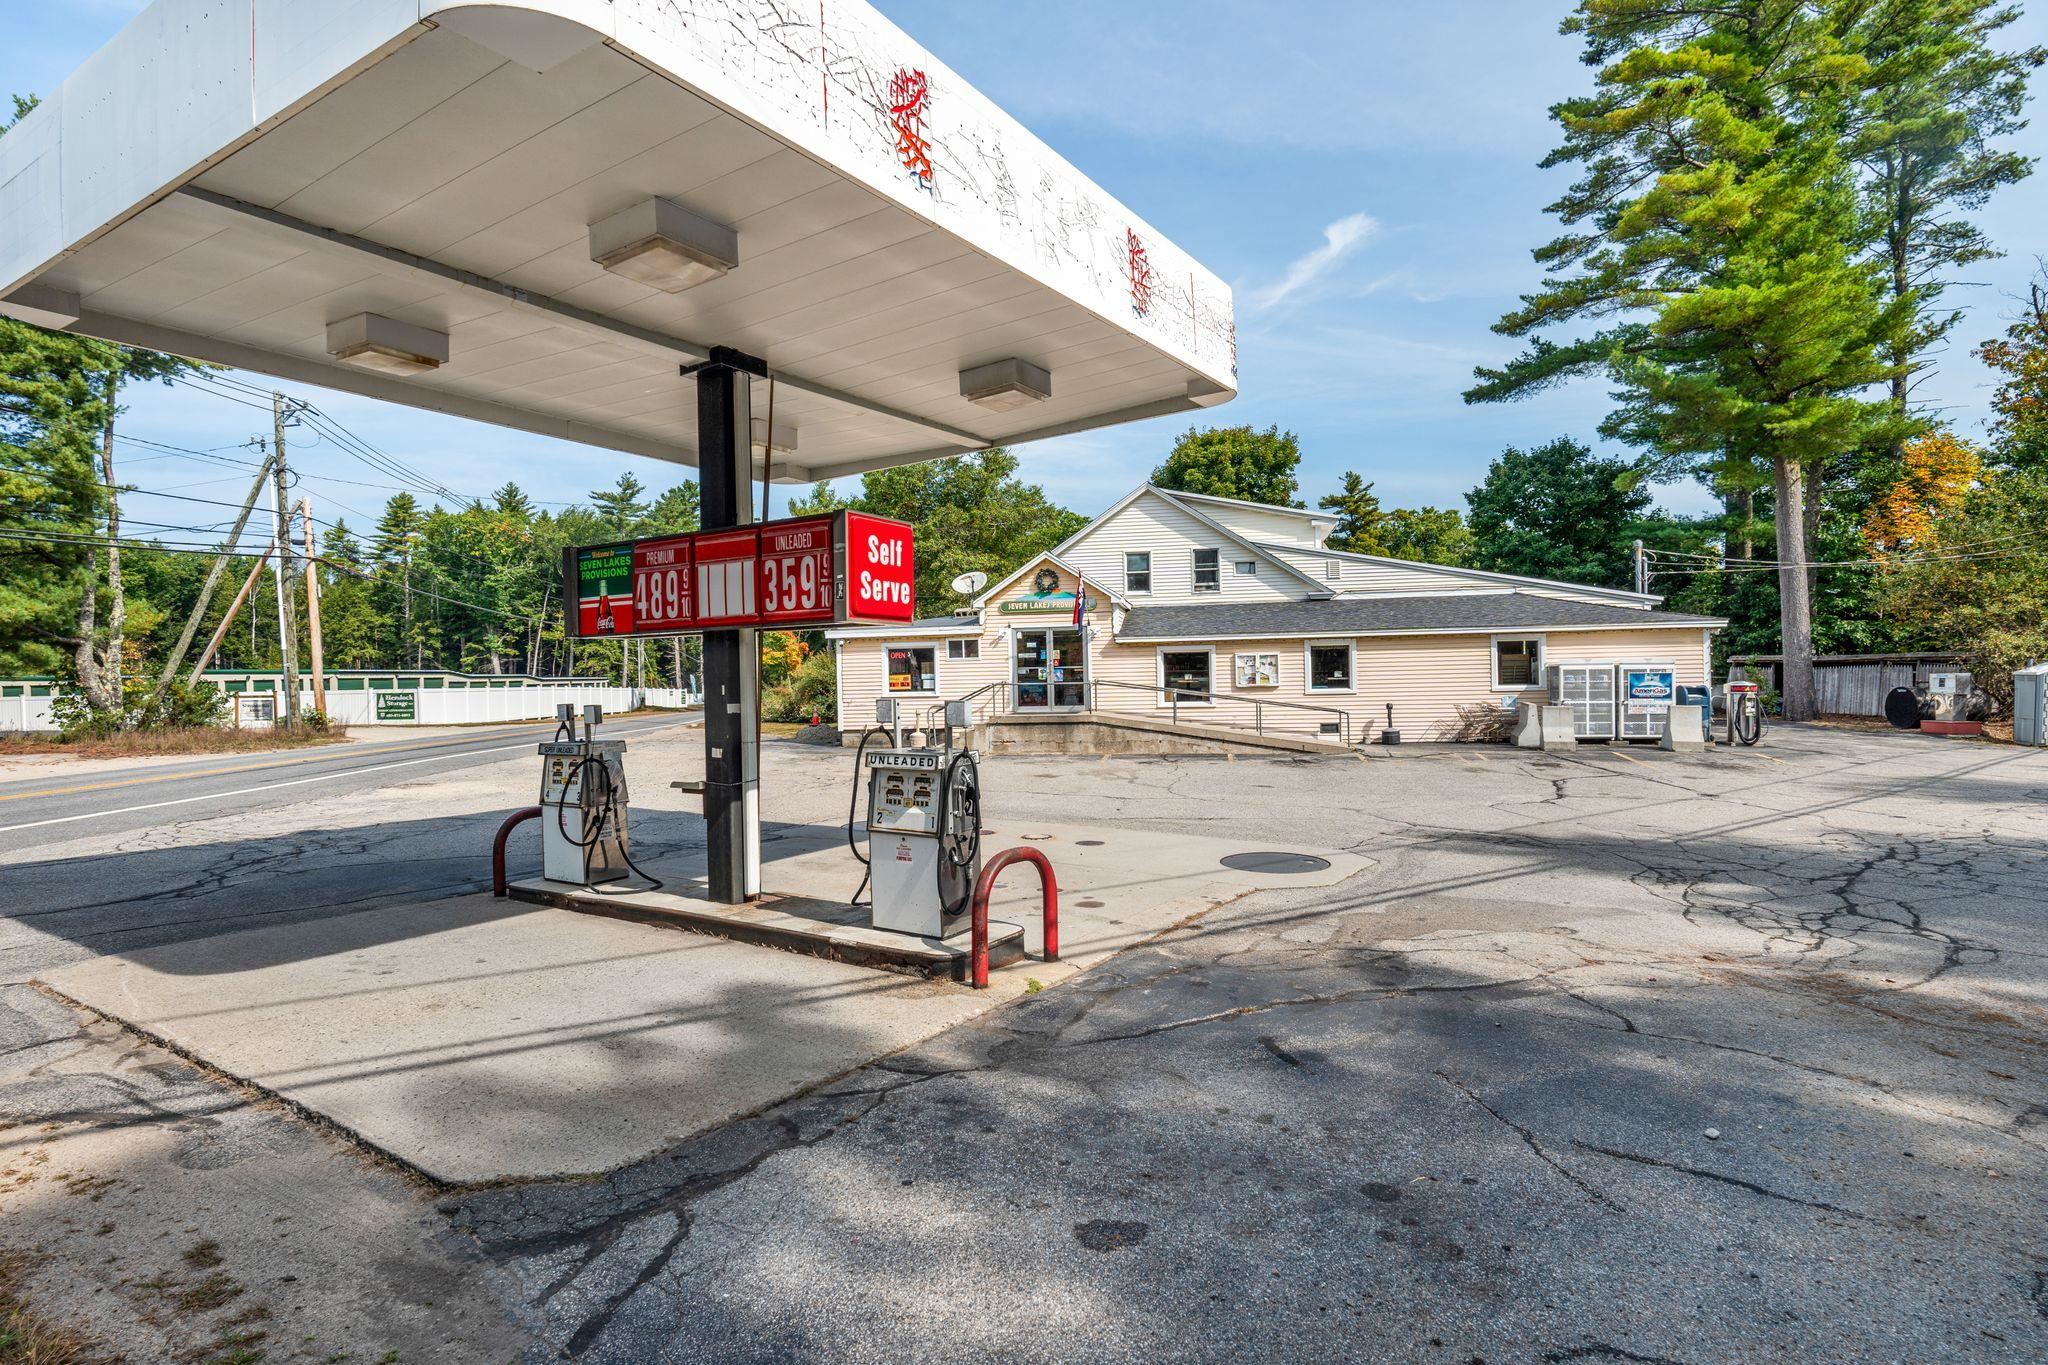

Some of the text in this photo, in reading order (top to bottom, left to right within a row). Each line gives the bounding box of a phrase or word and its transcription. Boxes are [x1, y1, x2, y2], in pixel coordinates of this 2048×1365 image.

[775, 532, 812, 551] UNLEADED
[646, 549, 675, 566] PREMIUM
[867, 534, 903, 567] Self
[580, 556, 631, 570] SEVEN LAKES
[581, 567, 629, 580] PROVISIONS
[764, 555, 816, 612] 359
[860, 570, 910, 605] Serve
[634, 570, 679, 620] 489
[1008, 601, 1027, 610] SEVEN
[1029, 601, 1050, 609] LAKES
[890, 651, 906, 659] OPEN
[870, 755, 934, 767] UNLEADED
[876, 812, 883, 824] 2
[930, 816, 935, 829] 1
